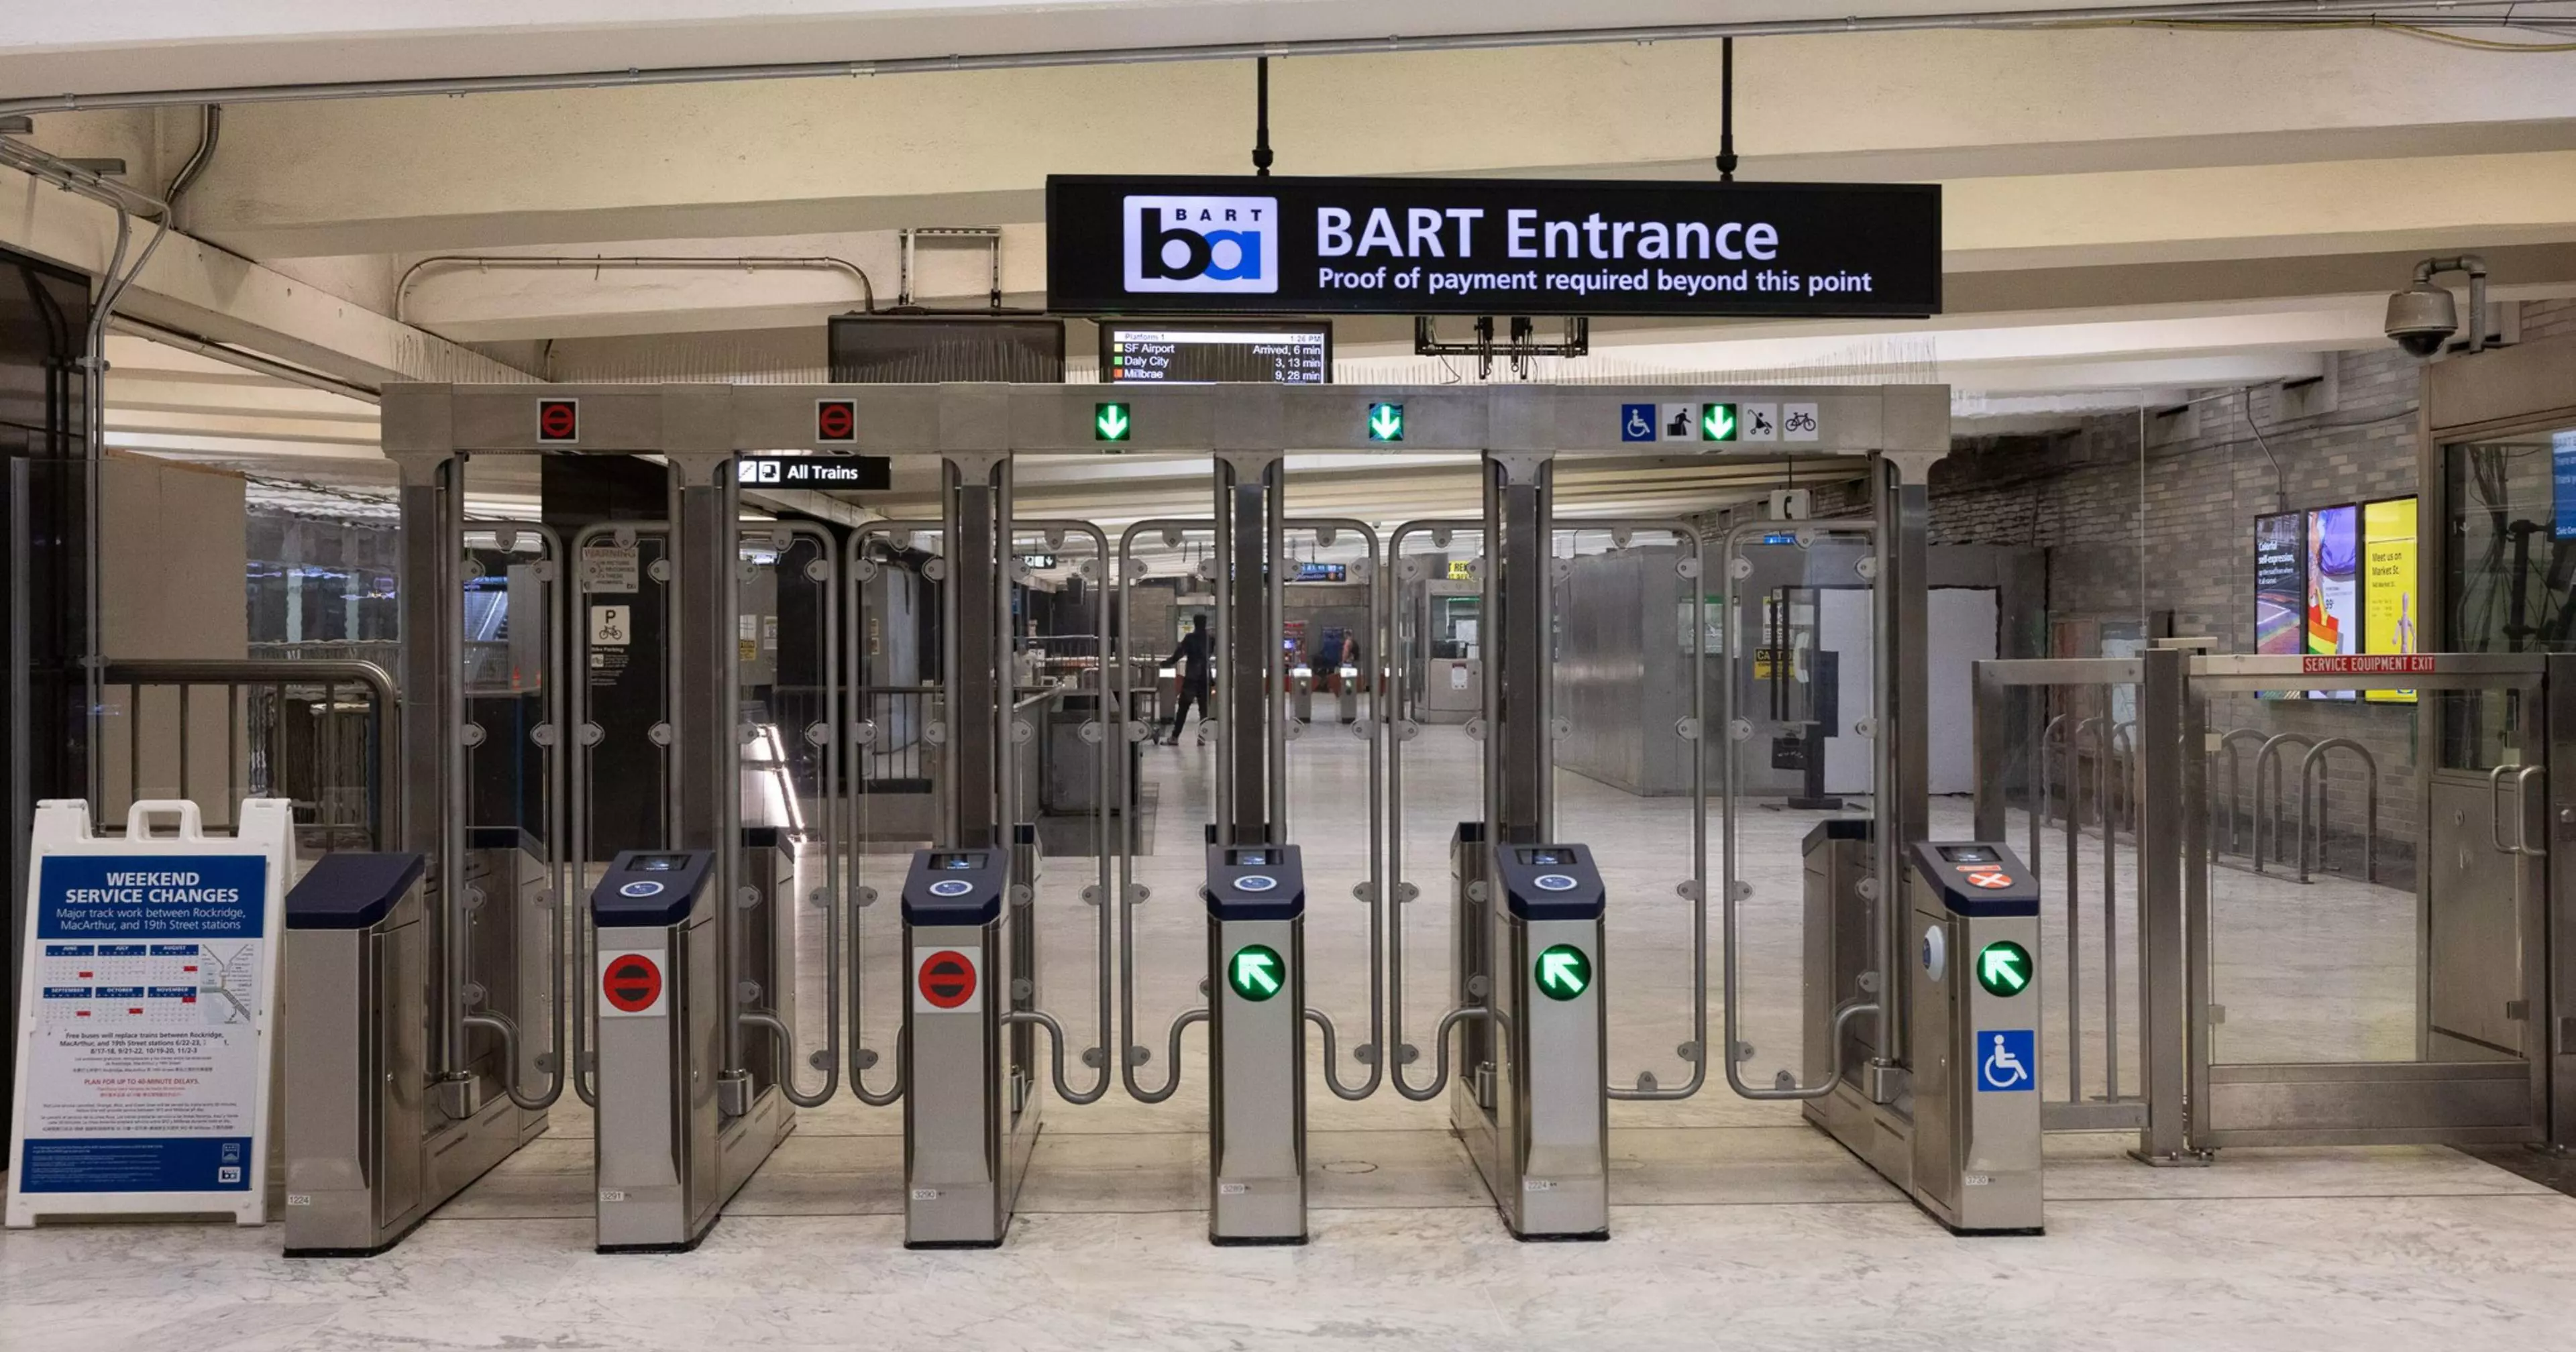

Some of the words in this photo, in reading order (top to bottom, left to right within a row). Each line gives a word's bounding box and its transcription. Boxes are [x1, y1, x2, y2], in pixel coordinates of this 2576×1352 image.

[1175, 209, 1263, 221] BART
[1318, 207, 1484, 258] BART
[1507, 209, 1779, 260] Entrance
[1319, 267, 1387, 289] Proof
[1394, 267, 1421, 290] of
[1429, 270, 1538, 295] payment
[1546, 269, 1648, 295] required
[1658, 269, 1747, 296] beyond
[1756, 270, 1801, 292] this
[1809, 270, 1872, 296] point
[1124, 343, 1140, 353] SF
[1142, 343, 1175, 355] Airport
[1252, 345, 1291, 356] Arrived,
[1294, 345, 1301, 354] 6
[1303, 345, 1321, 355] min
[1124, 356, 1146, 368] Daly
[1150, 356, 1169, 368] City
[1275, 358, 1285, 369] 3,
[1287, 358, 1301, 368] 13
[1303, 358, 1321, 368] min
[1124, 370, 1163, 379] Millbrae
[1275, 371, 1285, 382] 9,
[1287, 371, 1300, 380] 28
[1303, 371, 1321, 380] min
[787, 464, 808, 479] All
[812, 465, 859, 480] Trains
[2372, 553, 2386, 562] Meet
[2387, 553, 2394, 561] us
[2394, 553, 2402, 561] on
[2372, 566, 2392, 575] Market
[605, 610, 616, 624] P
[2305, 657, 2347, 671] SERVICE
[2351, 657, 2408, 671] EQUIPMENT
[2412, 656, 2434, 670] EXIT
[106, 872, 200, 887] WEEKEND
[65, 889, 143, 903] SERVICE
[148, 888, 239, 903] CHANGES
[56, 909, 87, 920] Major
[89, 909, 114, 918] track
[117, 909, 142, 918] work
[146, 908, 190, 918] between
[193, 907, 246, 919] Rockridge,
[61, 920, 117, 931] MacArthur,
[120, 919, 140, 930] and
[144, 919, 166, 929] 19th
[169, 919, 199, 929] Street
[201, 919, 241, 929] stations
[115, 1032, 138, 1040] replace
[189, 1031, 224, 1039] Rockridge,
[289, 1196, 309, 1204] 1224
